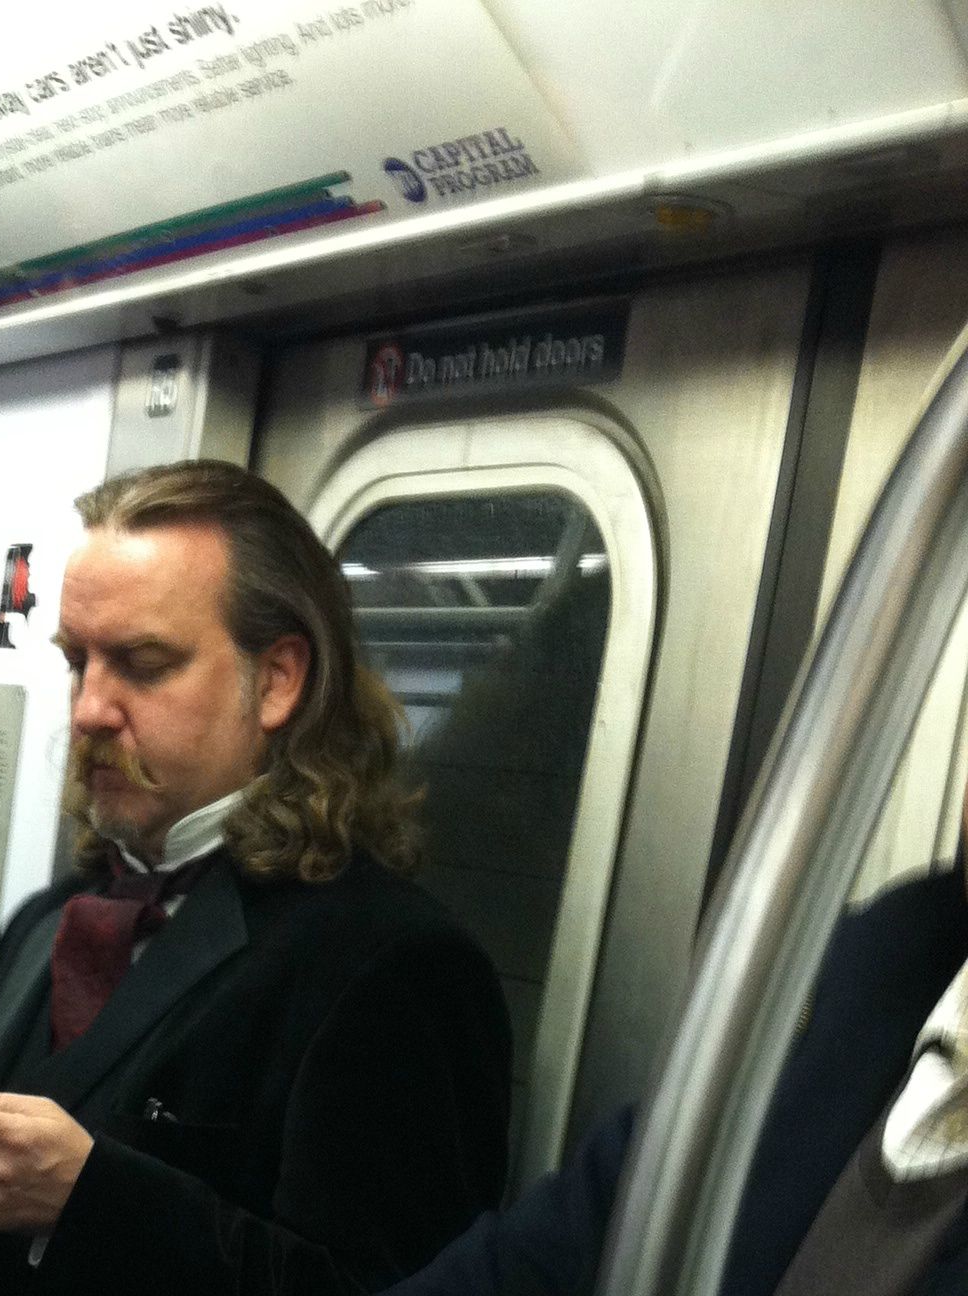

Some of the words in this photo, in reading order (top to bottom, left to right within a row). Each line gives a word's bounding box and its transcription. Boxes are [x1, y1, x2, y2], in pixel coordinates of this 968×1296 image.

[24, 70, 71, 103] cars
[68, 40, 131, 86] aren't
[125, 24, 172, 70] just
[168, 1, 241, 44] shiny.
[412, 127, 526, 174] CAPITAL
[427, 153, 541, 196] PROGRAM
[406, 352, 436, 385] Do
[440, 344, 476, 381] not
[479, 334, 532, 378] hold
[533, 332, 605, 369] doors
